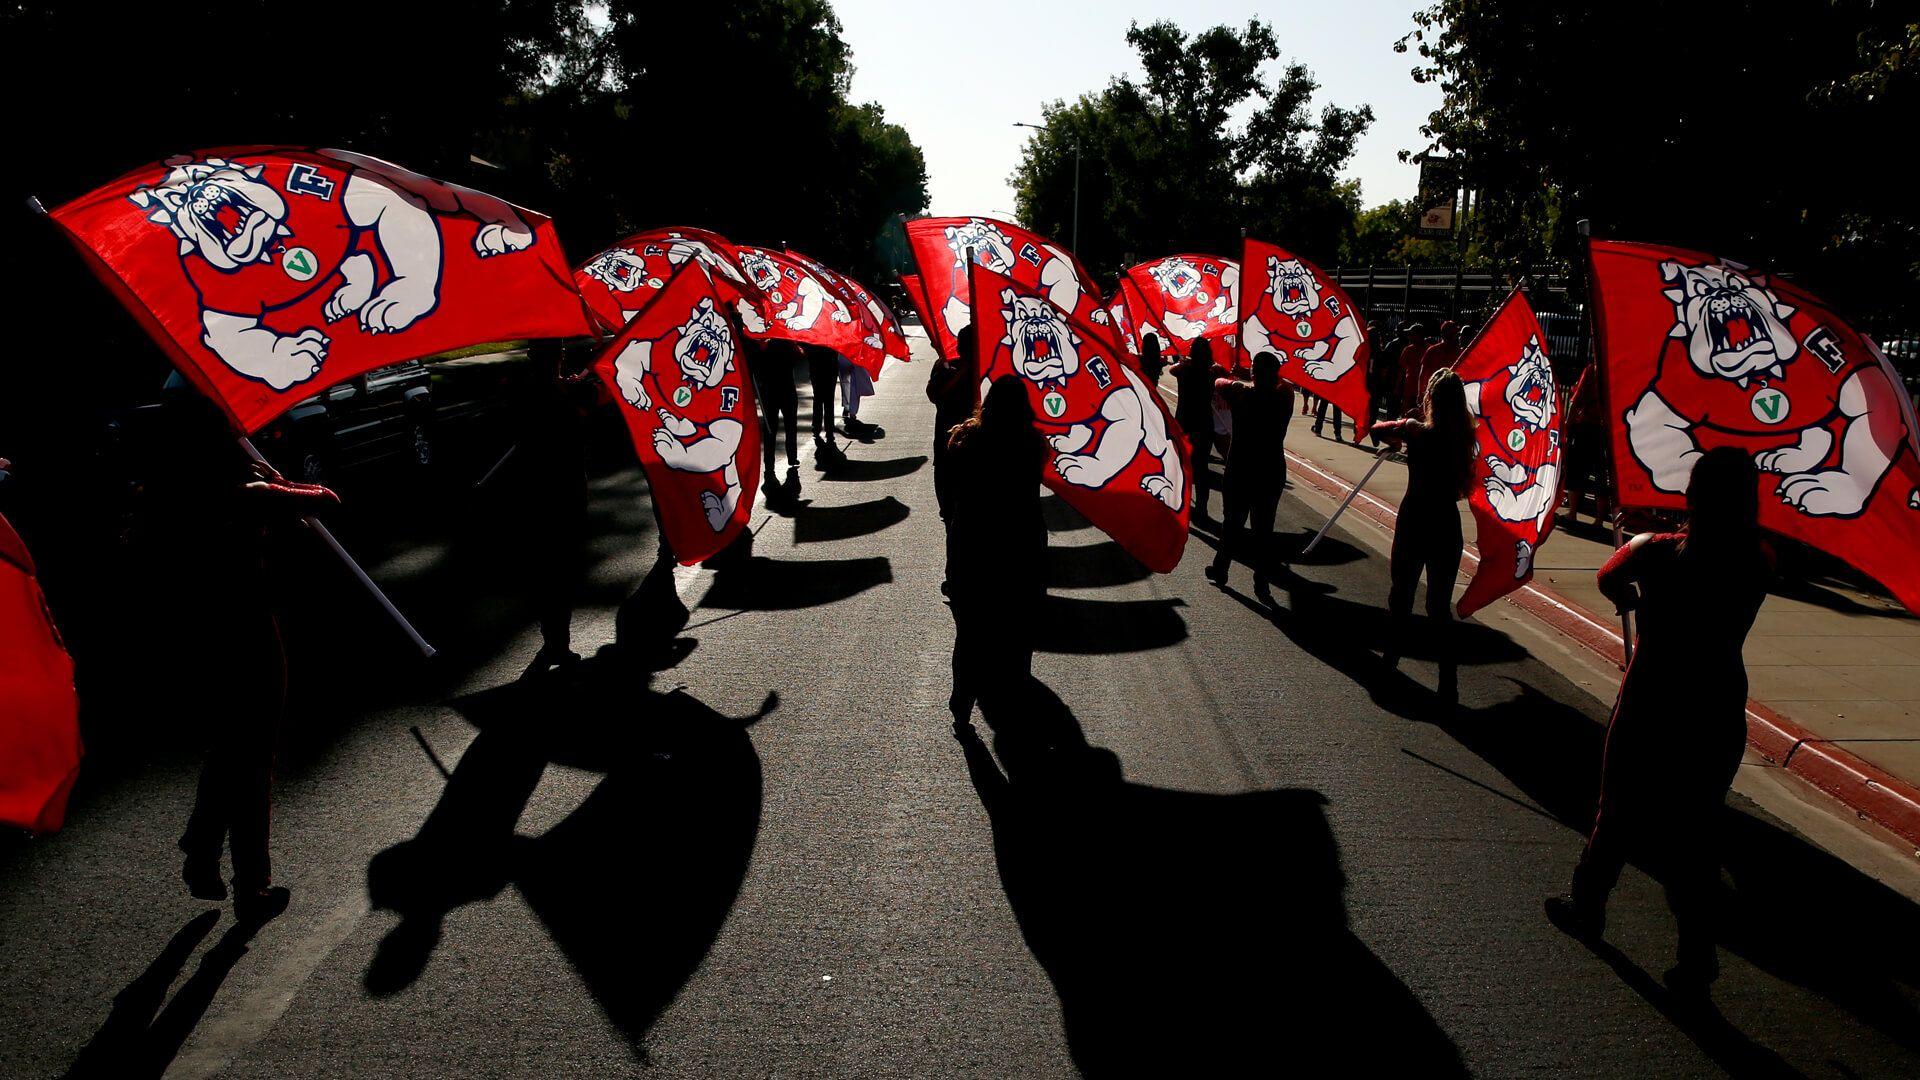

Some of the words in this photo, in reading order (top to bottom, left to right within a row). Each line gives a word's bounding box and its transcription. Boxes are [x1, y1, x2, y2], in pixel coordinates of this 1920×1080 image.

[286, 163, 334, 200] F
[286, 251, 312, 275] V
[1019, 243, 1042, 267] F
[1203, 263, 1218, 277] F
[1323, 295, 1341, 318] F
[1298, 324, 1309, 336] V
[1803, 325, 1845, 374] F
[1085, 356, 1111, 389] F
[677, 388, 690, 404] V
[720, 386, 740, 412] F
[1046, 397, 1062, 414] V
[1755, 394, 1781, 419] V
[1511, 431, 1524, 447] V
